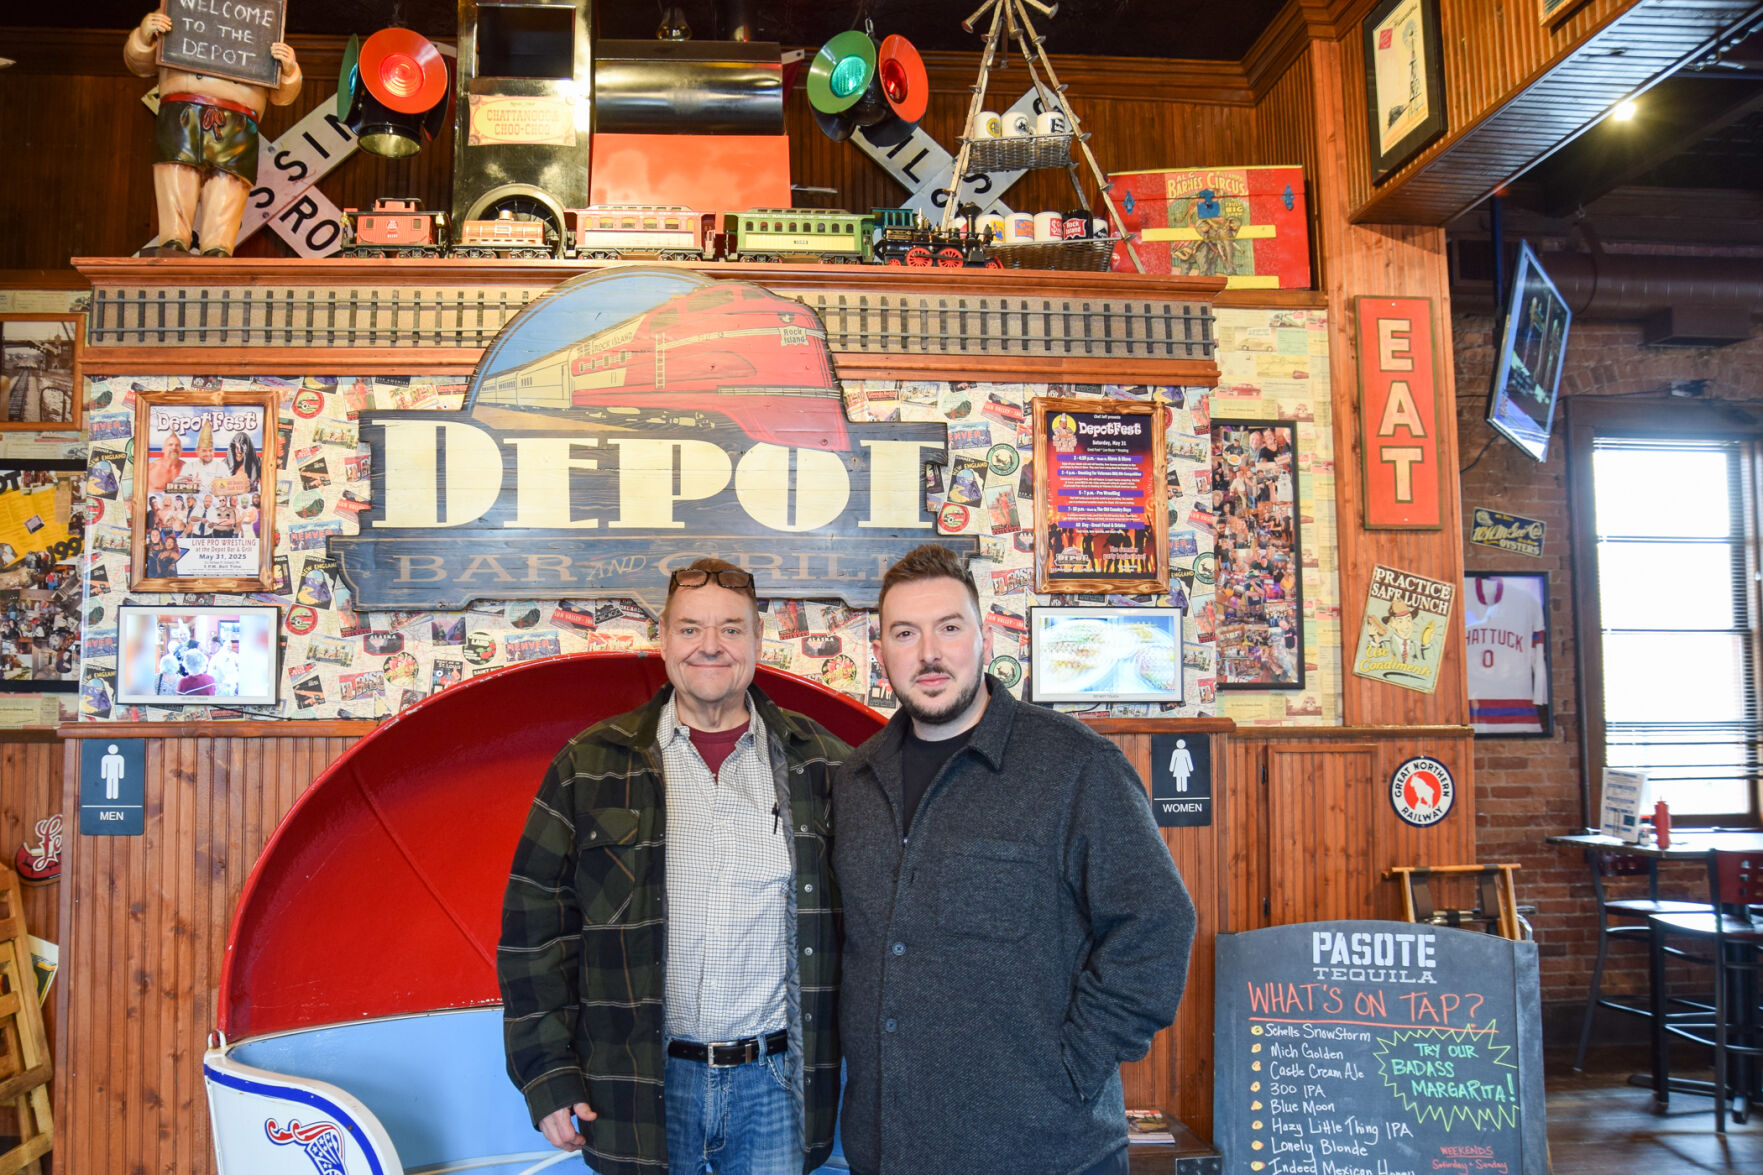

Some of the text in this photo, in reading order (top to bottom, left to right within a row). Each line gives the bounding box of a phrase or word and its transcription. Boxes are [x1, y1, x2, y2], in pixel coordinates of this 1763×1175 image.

[180, 0, 275, 27] WELCOME
[182, 18, 254, 43] TO THE
[182, 38, 257, 66] DEPOT
[1168, 177, 1203, 200] BARNES
[1206, 172, 1246, 196] CIRCUS
[784, 328, 802, 336] Rock
[1378, 318, 1428, 503] EAT
[1078, 422, 1142, 437] DepotFest
[372, 419, 946, 532] DEPOT
[1500, 539, 1540, 555] OYSTERS
[393, 554, 578, 584] BAR
[589, 554, 648, 580] AND
[1375, 567, 1451, 599] PRACTICE
[1404, 592, 1448, 615] LUNCH
[506, 639, 550, 651] DENVER
[1395, 762, 1450, 798] GREAT NORTHERN
[100, 812, 124, 821] MEN
[1162, 803, 1202, 813] WOMEN
[1402, 806, 1443, 822] RAILWAY
[1312, 932, 1437, 968] PASOTE
[1313, 967, 1438, 984] TEQUILA
[1248, 982, 1484, 1028] WHAT'S ON TAP?
[1271, 1042, 1344, 1060] Mich Golden
[1414, 1043, 1479, 1058] TRY OUR
[1270, 1061, 1364, 1080] Castle Cream Ale
[1392, 1059, 1455, 1078] BADASS
[1270, 1083, 1326, 1098] 300 IPA
[1411, 1073, 1516, 1102] MARGARITA!
[1271, 1099, 1335, 1116] Blue Moon
[1272, 1116, 1414, 1145] Hazy Little Thing IPA
[1271, 1137, 1369, 1162] Lonely Blonde
[1440, 1145, 1494, 1156] WEEKENDS
[1268, 1158, 1317, 1175] Indeed
[1322, 1160, 1372, 1175] Mexican
[1432, 1159, 1508, 1175] Saturday Sunday
